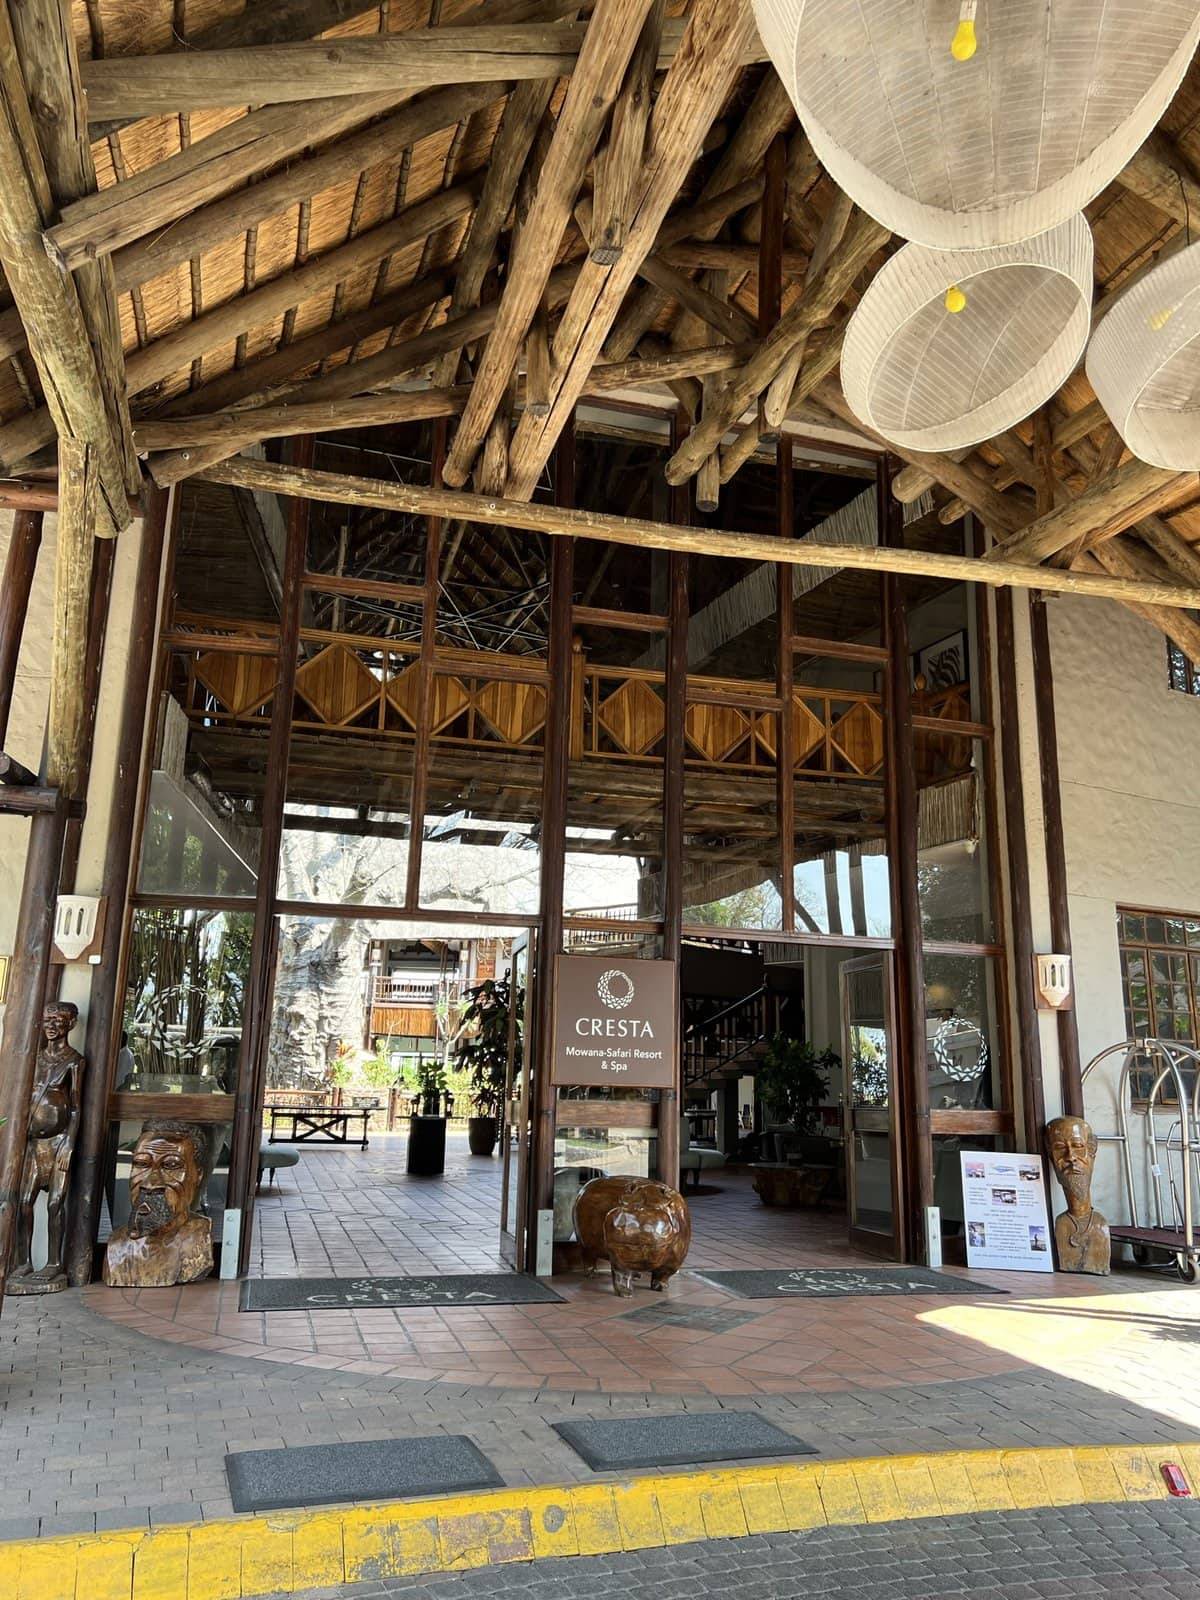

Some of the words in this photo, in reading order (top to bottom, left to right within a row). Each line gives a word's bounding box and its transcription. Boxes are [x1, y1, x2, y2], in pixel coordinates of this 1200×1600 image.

[575, 1017, 654, 1038] CRESTA
[565, 1046, 632, 1059] Mowana-Safari
[633, 1048, 662, 1060] Resort
[600, 1060, 608, 1071] &
[610, 1061, 628, 1073] Spa
[776, 1281, 938, 1292] CRESTA
[306, 1291, 497, 1303] CRESTA
